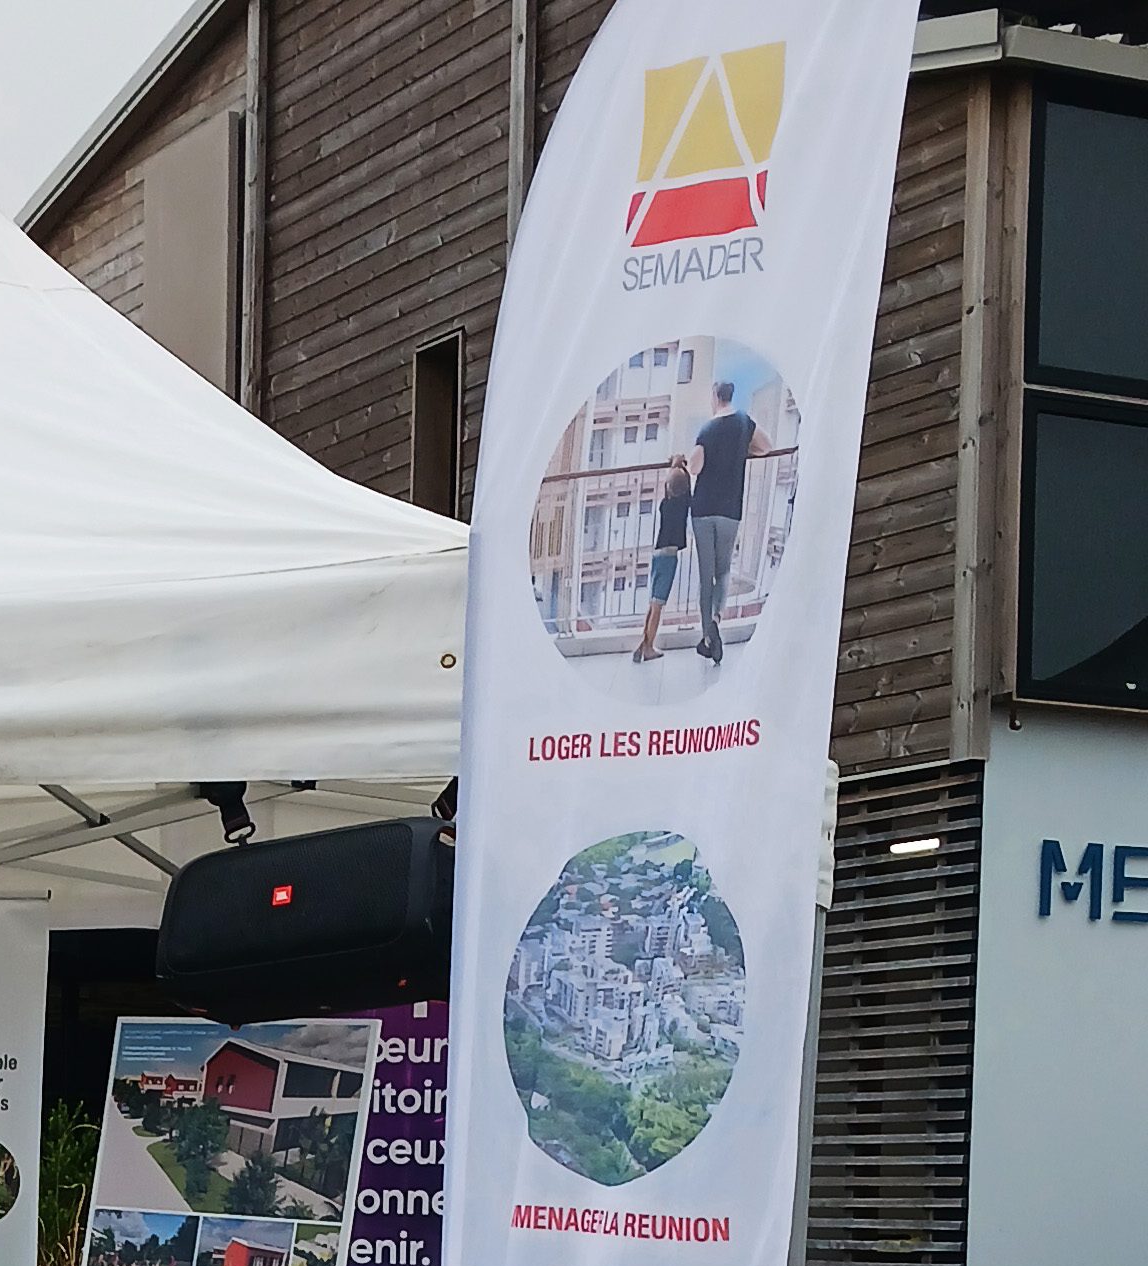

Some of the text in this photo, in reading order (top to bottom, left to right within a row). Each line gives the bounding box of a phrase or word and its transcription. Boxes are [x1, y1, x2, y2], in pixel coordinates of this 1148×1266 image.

[622, 236, 764, 292] SEMADER
[529, 733, 592, 761] LOGER
[600, 731, 641, 757] LES
[1039, 839, 1148, 922] ME
[375, 1035, 449, 1063] œur
[372, 1079, 448, 1114] itoir
[357, 1188, 445, 1215] onne
[603, 1210, 619, 1236] LA
[623, 1212, 730, 1242] REUNION
[351, 1230, 430, 1266] enir.
